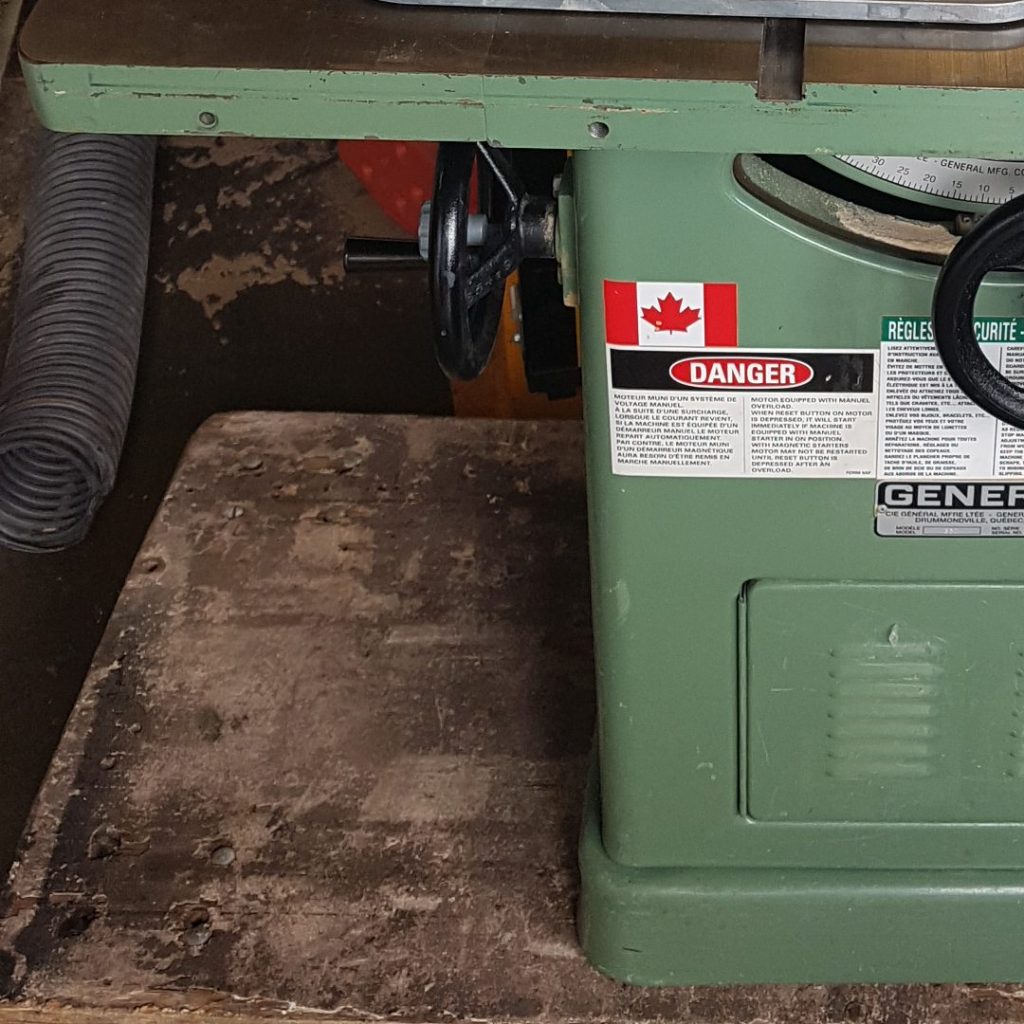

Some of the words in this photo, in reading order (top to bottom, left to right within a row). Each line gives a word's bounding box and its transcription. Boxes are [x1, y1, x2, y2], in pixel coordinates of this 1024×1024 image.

[871, 156, 886, 166] 30
[896, 166, 910, 176] 25
[940, 159, 984, 174] GENERAL
[987, 168, 1012, 176] MFG.
[922, 174, 936, 183] 20
[951, 180, 963, 189] 15
[978, 184, 990, 193] 10
[1009, 186, 1015, 194] 5
[888, 317, 934, 340] RÈGLES
[973, 318, 1017, 341] CURITÉ
[690, 362, 796, 384] DANGER
